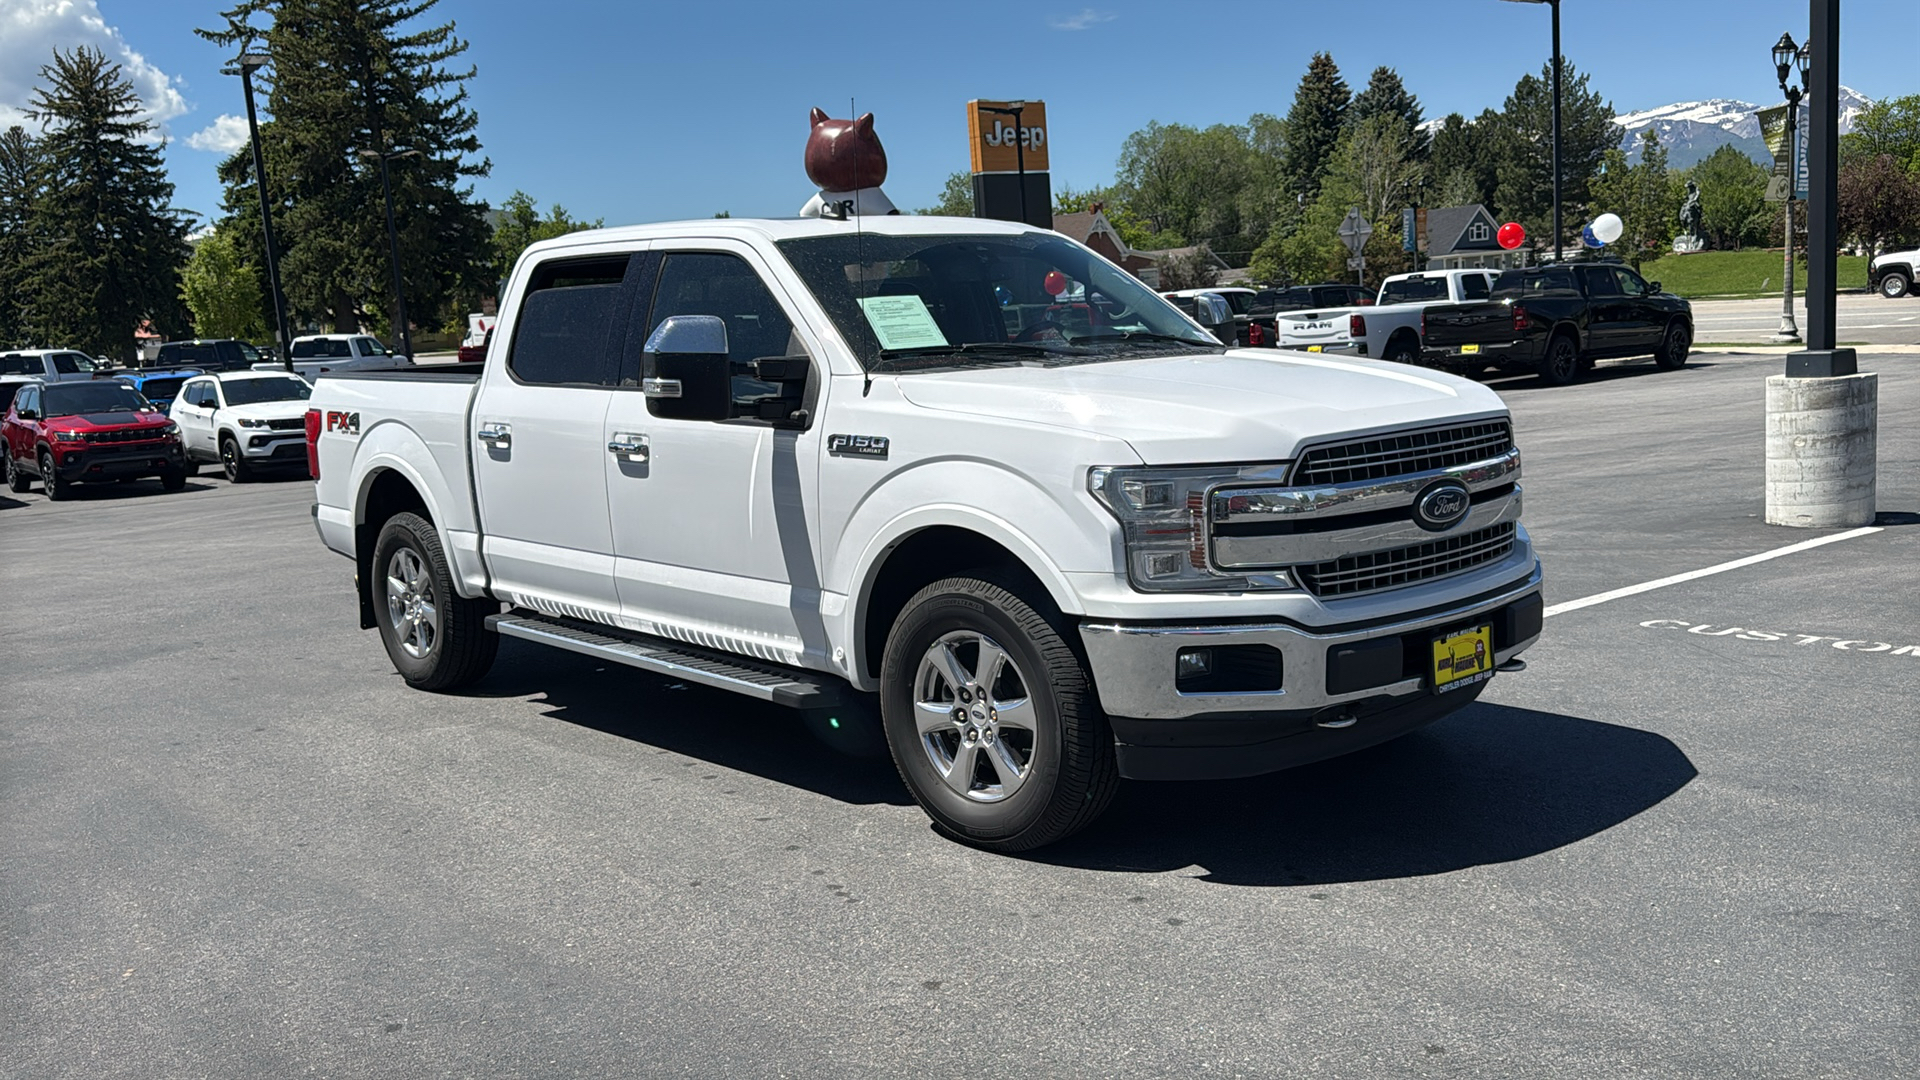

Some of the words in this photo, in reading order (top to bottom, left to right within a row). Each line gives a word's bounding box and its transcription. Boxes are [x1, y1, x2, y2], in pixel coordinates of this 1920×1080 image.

[985, 120, 1044, 151] Jeep
[821, 199, 855, 215] CR
[1293, 321, 1333, 330] RAM
[327, 410, 360, 432] FX4
[1434, 494, 1461, 515] Ford
[1439, 681, 1460, 693] CHRYSLER
[1459, 675, 1474, 687] DODGE
[1474, 672, 1483, 682] JEEP
[1483, 669, 1492, 679] RAM
